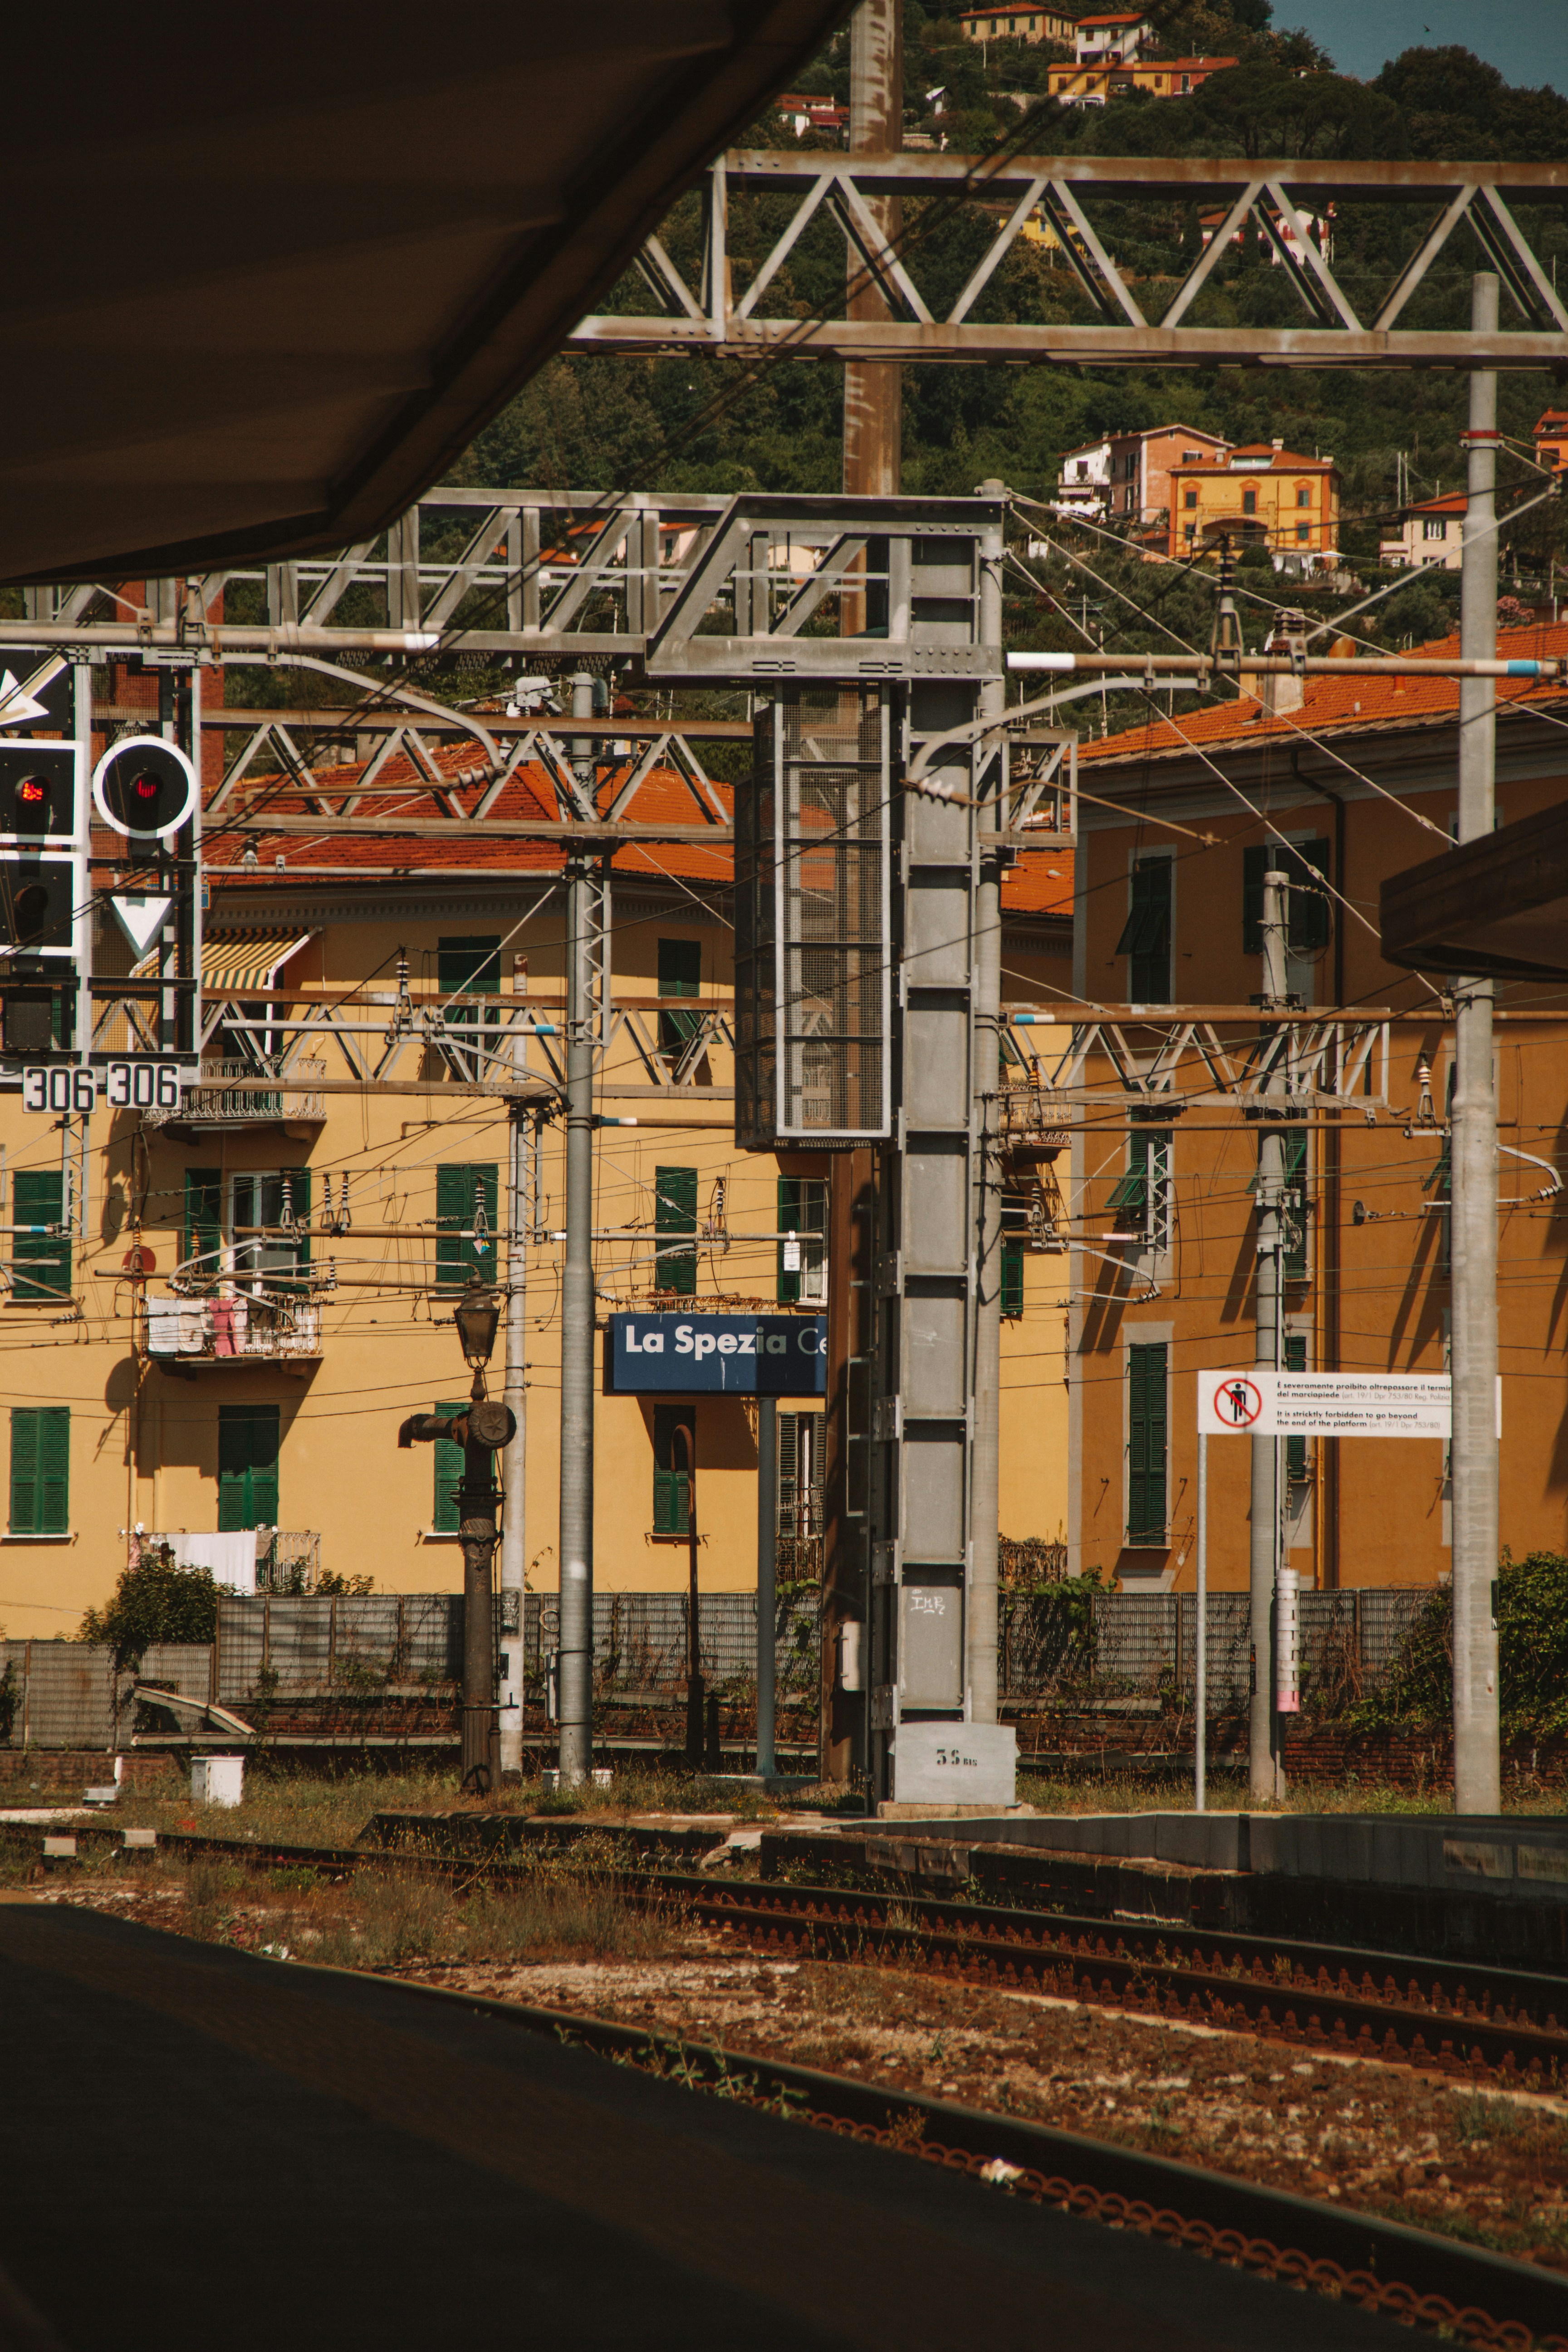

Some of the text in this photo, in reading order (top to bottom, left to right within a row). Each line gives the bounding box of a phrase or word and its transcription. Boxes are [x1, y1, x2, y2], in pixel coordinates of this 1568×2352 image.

[26, 1068, 93, 1112] 306
[110, 1063, 177, 1108] 306
[626, 1325, 664, 1352] La
[675, 1325, 787, 1361] Spezia
